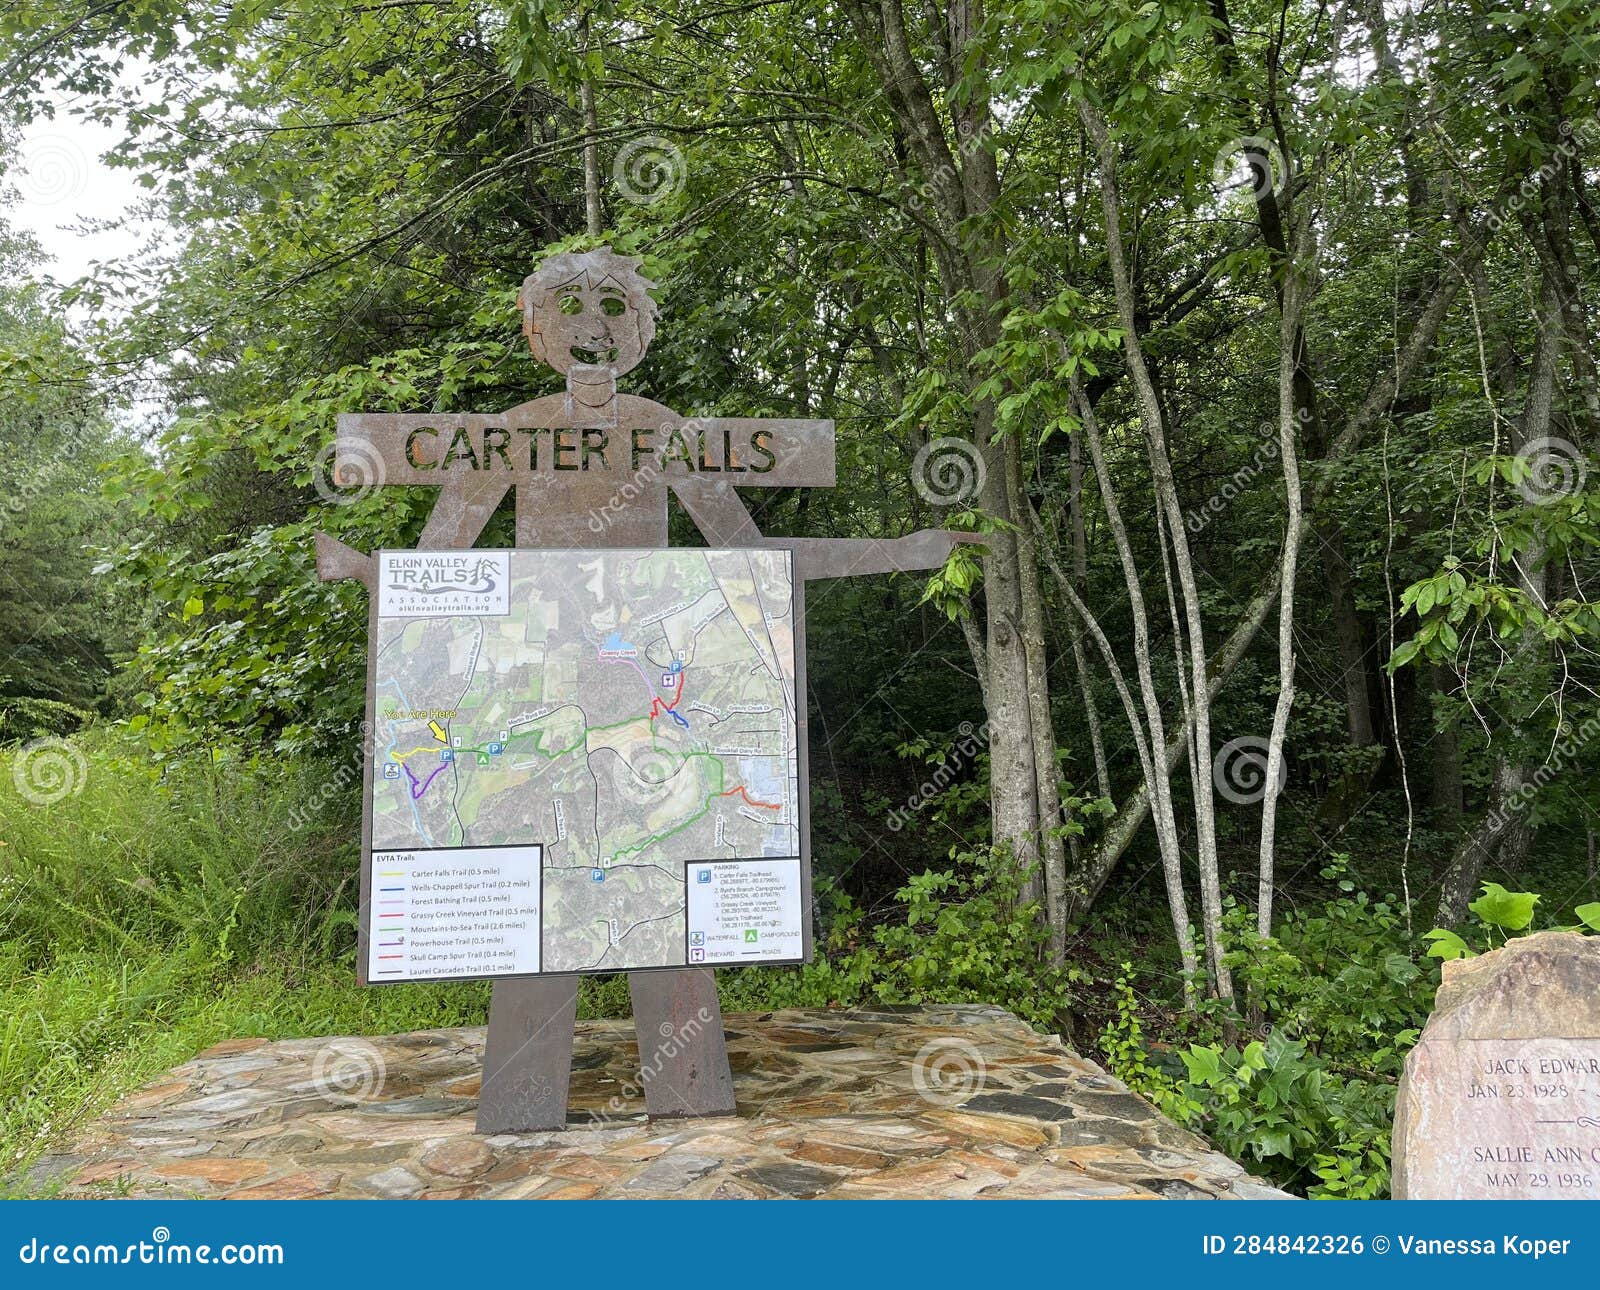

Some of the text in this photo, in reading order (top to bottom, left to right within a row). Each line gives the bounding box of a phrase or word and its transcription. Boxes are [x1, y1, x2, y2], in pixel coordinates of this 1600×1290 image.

[405, 427, 778, 473] CARTER FALLS
[389, 558, 468, 568] ELKIN VALLEY
[389, 569, 467, 583] TRAILS
[398, 604, 490, 613] elkinvalleytrails.org
[600, 649, 620, 657] Grassy
[408, 708, 427, 719] Are
[430, 708, 457, 718] Here
[468, 868, 481, 877] (0.5
[482, 868, 500, 876] mile)
[464, 883, 480, 891] Spur
[498, 881, 511, 890] (0.2
[435, 897, 461, 905] Bathing
[478, 895, 492, 904] (0.5
[493, 895, 511, 903] mile)
[411, 912, 434, 920] Grassy
[457, 910, 488, 918] Vineyard
[505, 908, 518, 916] (0.5
[520, 907, 537, 915] mile)
[411, 925, 472, 933] Mountains-to-Sea
[490, 923, 504, 931] (2.6
[505, 922, 526, 930] miles)
[472, 937, 485, 946] (0.5
[486, 936, 504, 944] mile)
[428, 953, 448, 961] Camp
[449, 952, 465, 960] Spur
[484, 950, 497, 959] (0.4
[498, 950, 516, 958] mile)
[483, 965, 496, 973] (0.1
[1485, 1058, 1600, 1074] JACK EDWAR
[1533, 1084, 1569, 1098] 1928
[1473, 1147, 1534, 1163] SALLIE
[1544, 1147, 1583, 1163] ANN
[1486, 1173, 1520, 1187] MAY
[1558, 1173, 1593, 1188] 1936
